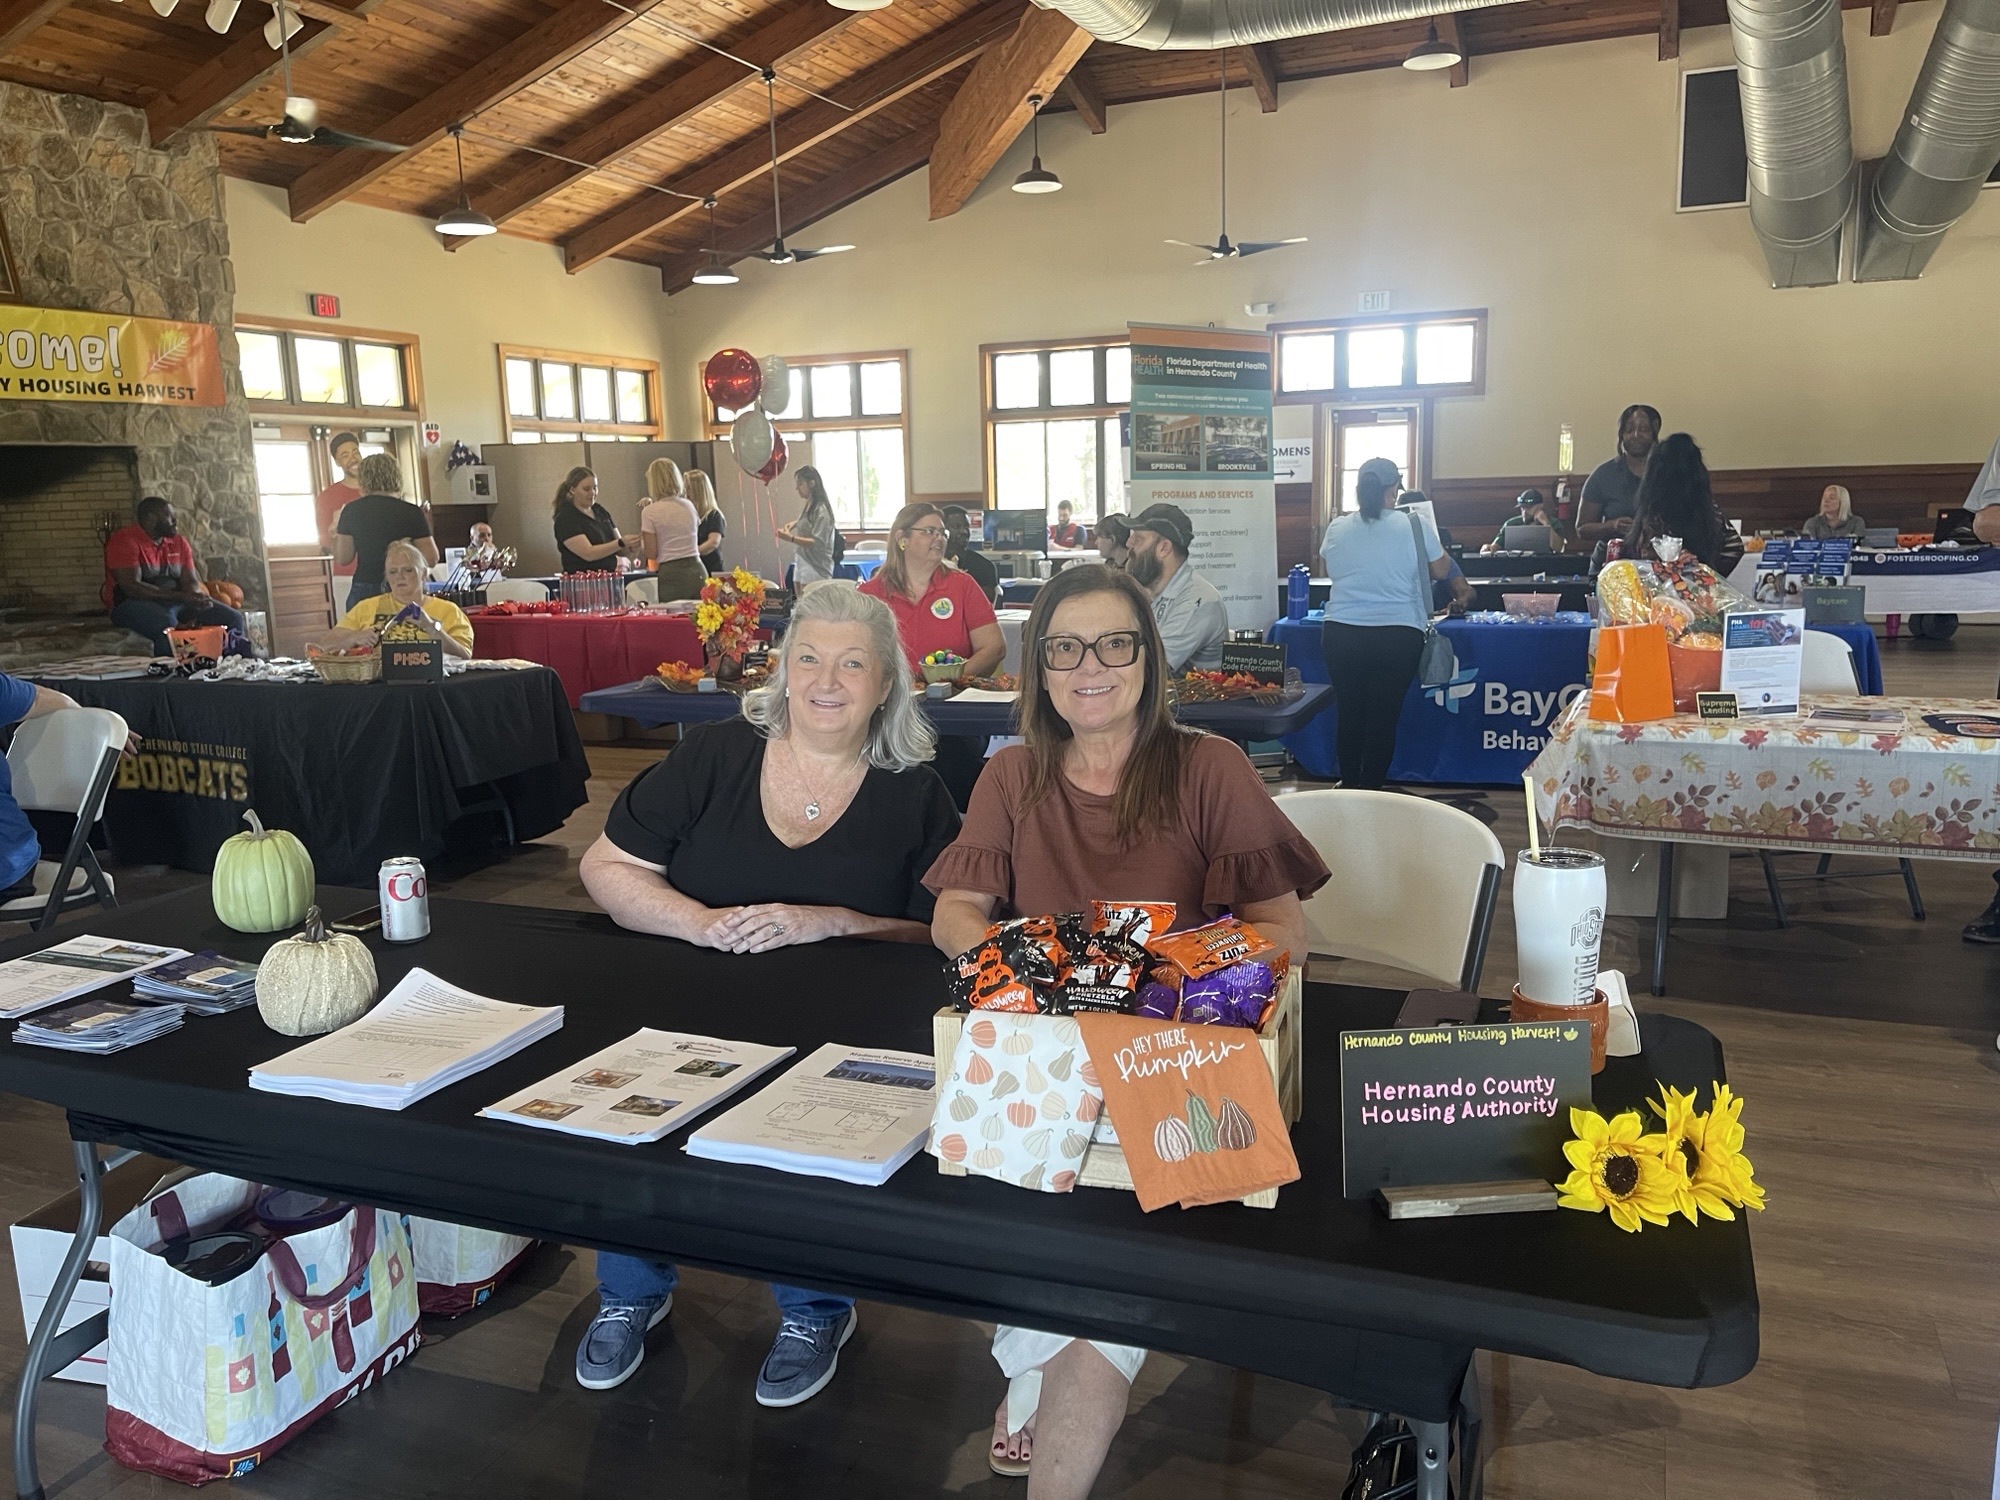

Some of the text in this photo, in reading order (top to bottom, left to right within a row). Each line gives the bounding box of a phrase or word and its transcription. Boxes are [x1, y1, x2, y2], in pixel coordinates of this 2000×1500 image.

[317, 296, 337, 316] EXIT
[1364, 293, 1386, 310] EXIT
[0, 325, 123, 378] ome!
[1134, 355, 1163, 366] Florida
[1166, 357, 1191, 367] Florida
[1192, 359, 1236, 369] Department
[1244, 362, 1267, 370] Health
[1134, 366, 1163, 375] HEALTH
[1175, 368, 1211, 376] Hernando
[1212, 369, 1237, 380] County
[20, 379, 110, 395] HOUSING
[118, 383, 196, 400] HARVEST
[1273, 447, 1310, 457] OMENS
[1152, 491, 1254, 499] PROGRAMS AND SERVICES
[393, 652, 431, 666] PHSC
[1222, 662, 1284, 673] Code Enforcement
[1224, 654, 1284, 667] Hernando County
[1484, 682, 1587, 727] BayC
[1700, 699, 1736, 707] Supreme
[1703, 706, 1736, 715] Lending
[1483, 729, 1553, 751] Behav
[190, 742, 214, 756] STATE
[215, 744, 247, 759] COLLEGE
[117, 752, 248, 801] BOBCATS
[1076, 992, 1115, 1001] PRETZELS
[1132, 1027, 1188, 1056] HEY THERE
[1344, 1026, 1561, 1050] Hernando County Housing Harvest!
[1113, 1039, 1246, 1083] Pumpkin
[1364, 1074, 1556, 1101] Hernando County
[1361, 1096, 1559, 1125] Housing Authority
